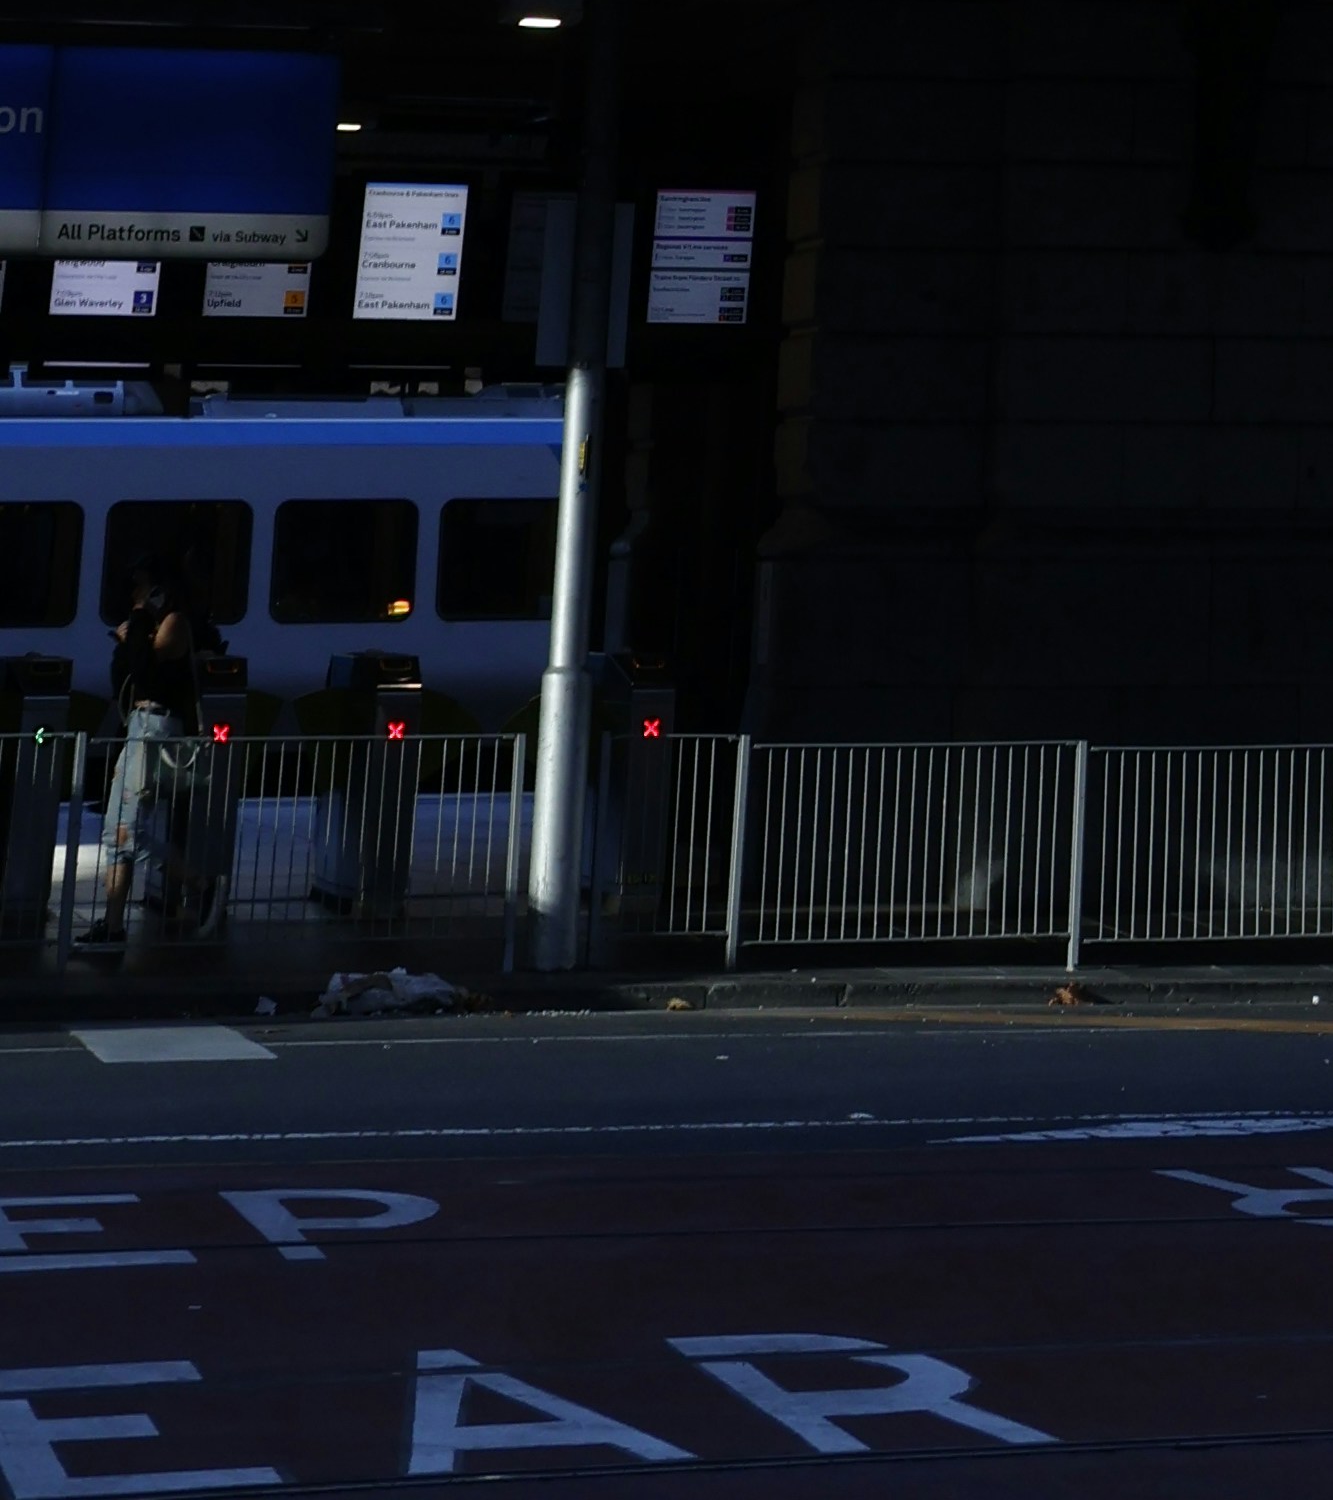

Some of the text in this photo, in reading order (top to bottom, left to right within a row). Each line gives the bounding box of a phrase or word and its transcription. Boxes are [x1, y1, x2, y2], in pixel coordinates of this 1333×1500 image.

[366, 220, 438, 229] East Pakenham
[58, 223, 286, 245] All Platforms via Subway
[361, 260, 416, 269] Cranbourne
[444, 255, 451, 265] 6
[54, 299, 123, 309] Glen Waverley
[207, 299, 242, 308] Upfield
[358, 300, 430, 309] East Pakenham
[0, 1332, 1062, 1499] EAR
